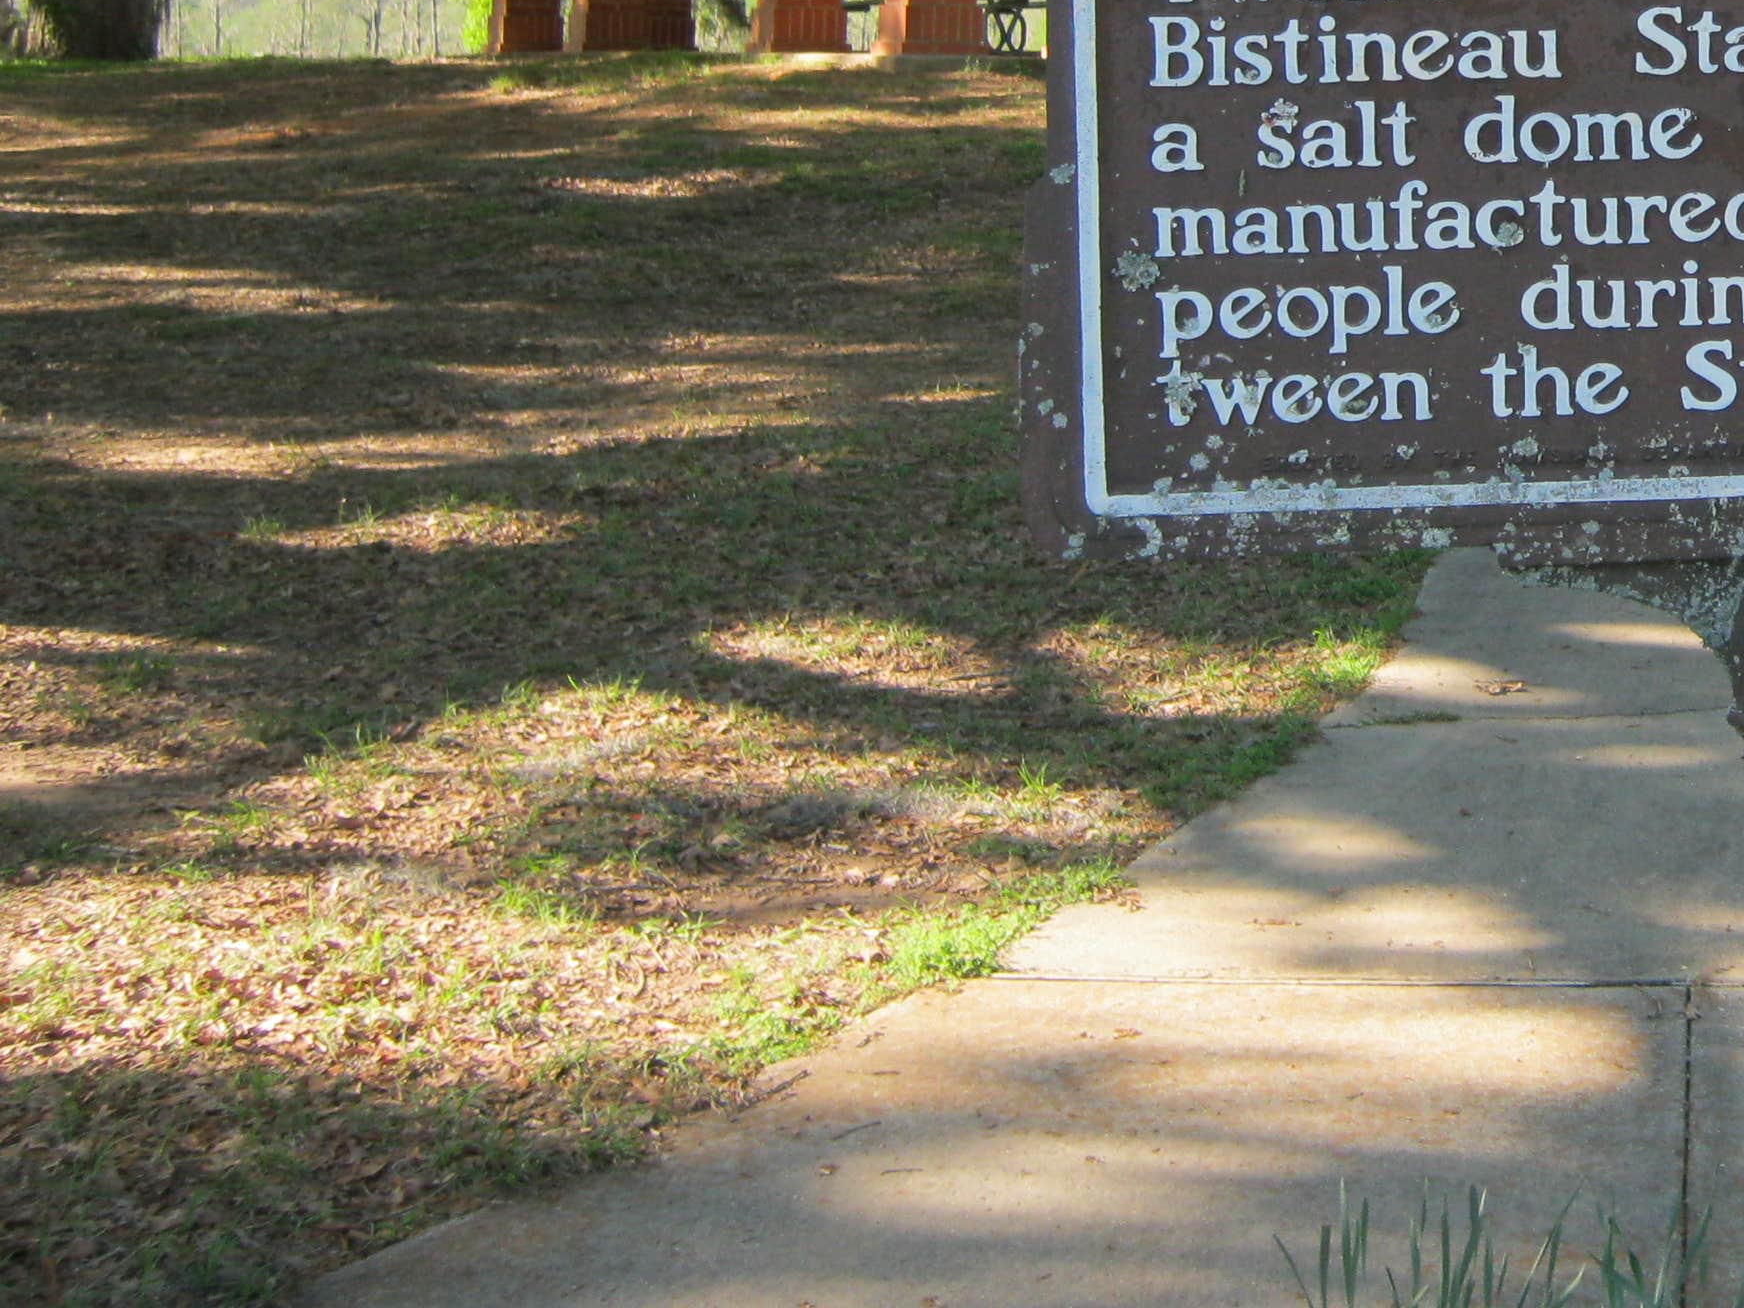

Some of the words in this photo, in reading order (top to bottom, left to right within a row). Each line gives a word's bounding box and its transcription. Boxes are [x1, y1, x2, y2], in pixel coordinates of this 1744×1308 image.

[1147, 14, 1563, 88] Bistineau
[1150, 121, 1206, 174] a
[1256, 96, 1418, 170] salt
[1463, 93, 1704, 169] dome
[1153, 264, 1461, 359] people
[1155, 358, 1434, 428] tween
[1479, 340, 1630, 419] the
